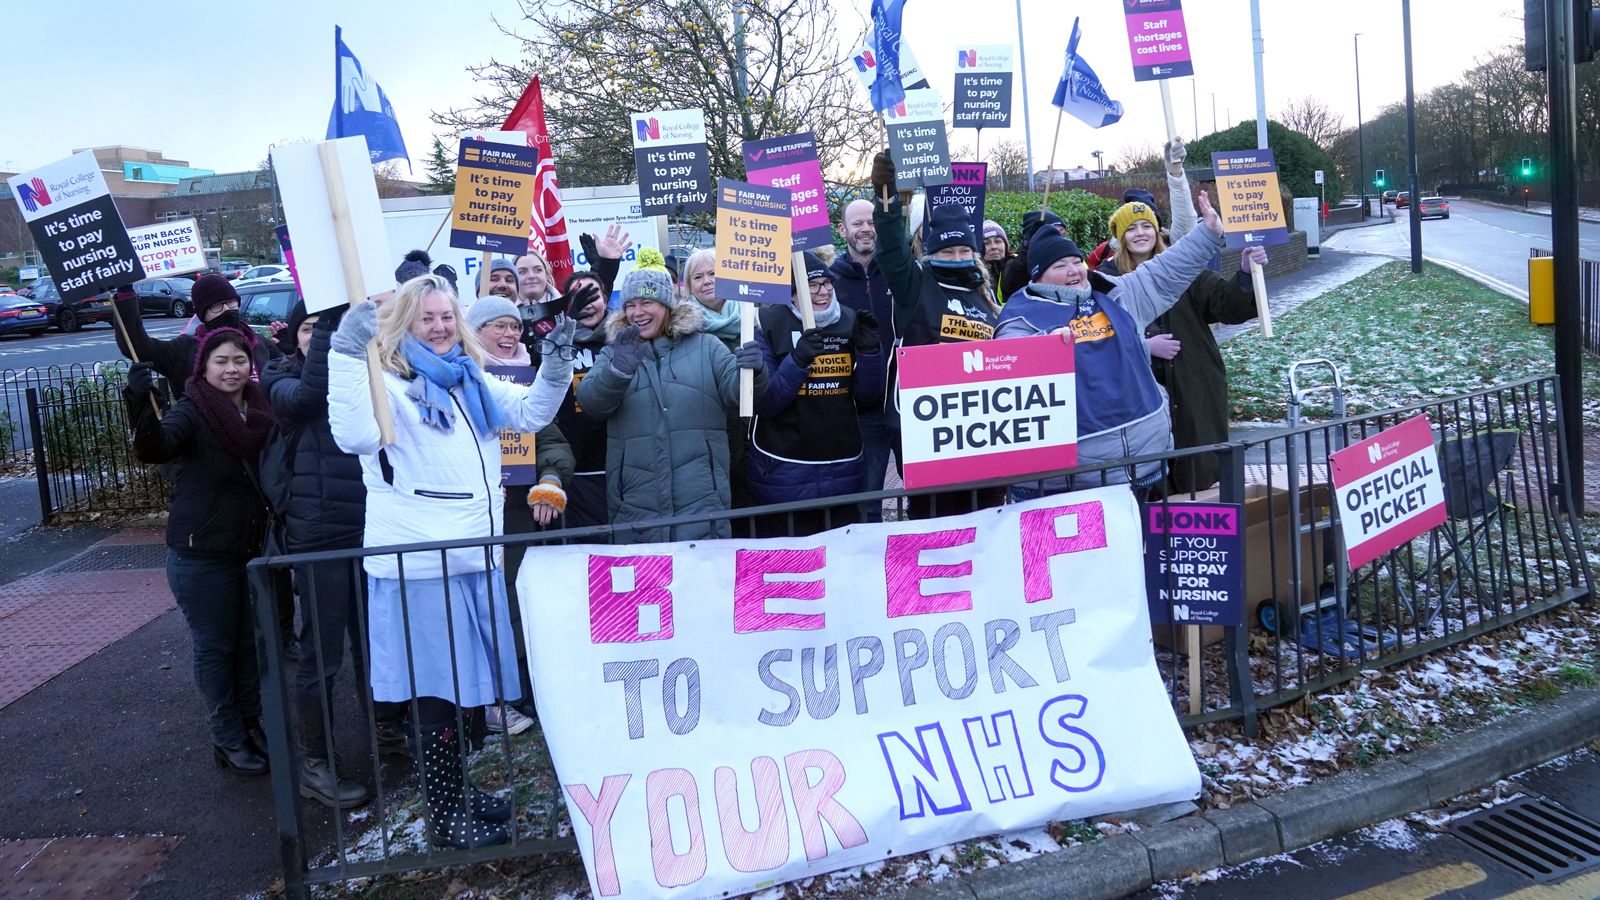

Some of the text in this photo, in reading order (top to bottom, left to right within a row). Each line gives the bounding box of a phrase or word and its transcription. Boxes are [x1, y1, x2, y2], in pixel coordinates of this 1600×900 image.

[1143, 20, 1168, 30] Staff
[1134, 32, 1182, 42] shortages
[1137, 43, 1182, 54] cost lives
[900, 68, 918, 79] RSING
[964, 77, 1002, 85] It's time
[1075, 71, 1101, 90] Royal
[980, 90, 998, 98] pay
[964, 100, 1000, 110] nursing
[982, 112, 1007, 121] fairly
[897, 127, 936, 138] It's time
[783, 142, 812, 151] STAFFING
[903, 142, 934, 152] to pay
[482, 150, 500, 158] FAIR
[648, 150, 696, 163] It's time
[902, 154, 940, 165] nursing
[482, 156, 532, 168] FOR NURSING
[654, 166, 692, 177] to pay
[898, 166, 949, 179] staff fairly
[953, 169, 980, 181] NK
[70, 170, 95, 187] College
[470, 174, 521, 188] It's time
[652, 178, 697, 191] nursing
[772, 174, 800, 188] Staff
[1227, 179, 1267, 189] It's time
[55, 184, 91, 202] of Nursing
[475, 187, 514, 202] to pay
[645, 191, 707, 206] staff fairly
[738, 191, 755, 199] FAIR
[792, 188, 818, 202] ages
[1246, 192, 1264, 200] pay
[469, 200, 517, 215] nursing
[754, 200, 786, 210] NURSING
[1232, 201, 1269, 211] nursing
[44, 209, 102, 237] It's time
[460, 212, 524, 229] staff fairly
[729, 216, 778, 232] It's time
[1228, 212, 1278, 224] staff fairly
[160, 226, 192, 238] BACKS
[58, 228, 103, 252] to pay
[153, 236, 191, 248] NURSES
[734, 232, 772, 247] to pay
[62, 243, 117, 272] nursing
[141, 246, 197, 262] CTORY TO
[730, 246, 776, 261] nursing
[721, 259, 784, 276] staff fairly
[60, 270, 94, 292] staff
[95, 257, 134, 281] fairly
[948, 319, 992, 335] THE VOICE
[960, 329, 992, 340] NURSIN
[818, 357, 846, 365] VOICE
[811, 366, 850, 374] NURSING
[913, 382, 1066, 421] OFFICIAL
[932, 415, 1050, 452] PICKET
[1346, 456, 1433, 511] OFFICIAL
[1361, 483, 1427, 534] PICKET
[1156, 512, 1231, 530] HONK
[1170, 537, 1217, 548] IF YOU
[1159, 550, 1228, 562] SUPPORT
[589, 501, 1108, 643] BEEP
[1160, 563, 1228, 575] FAIR PAY
[1178, 576, 1209, 587] FOR
[1160, 589, 1228, 601] NURSING
[603, 609, 1077, 740] TO SUPPORT
[564, 695, 1106, 896] YOUR NHS
